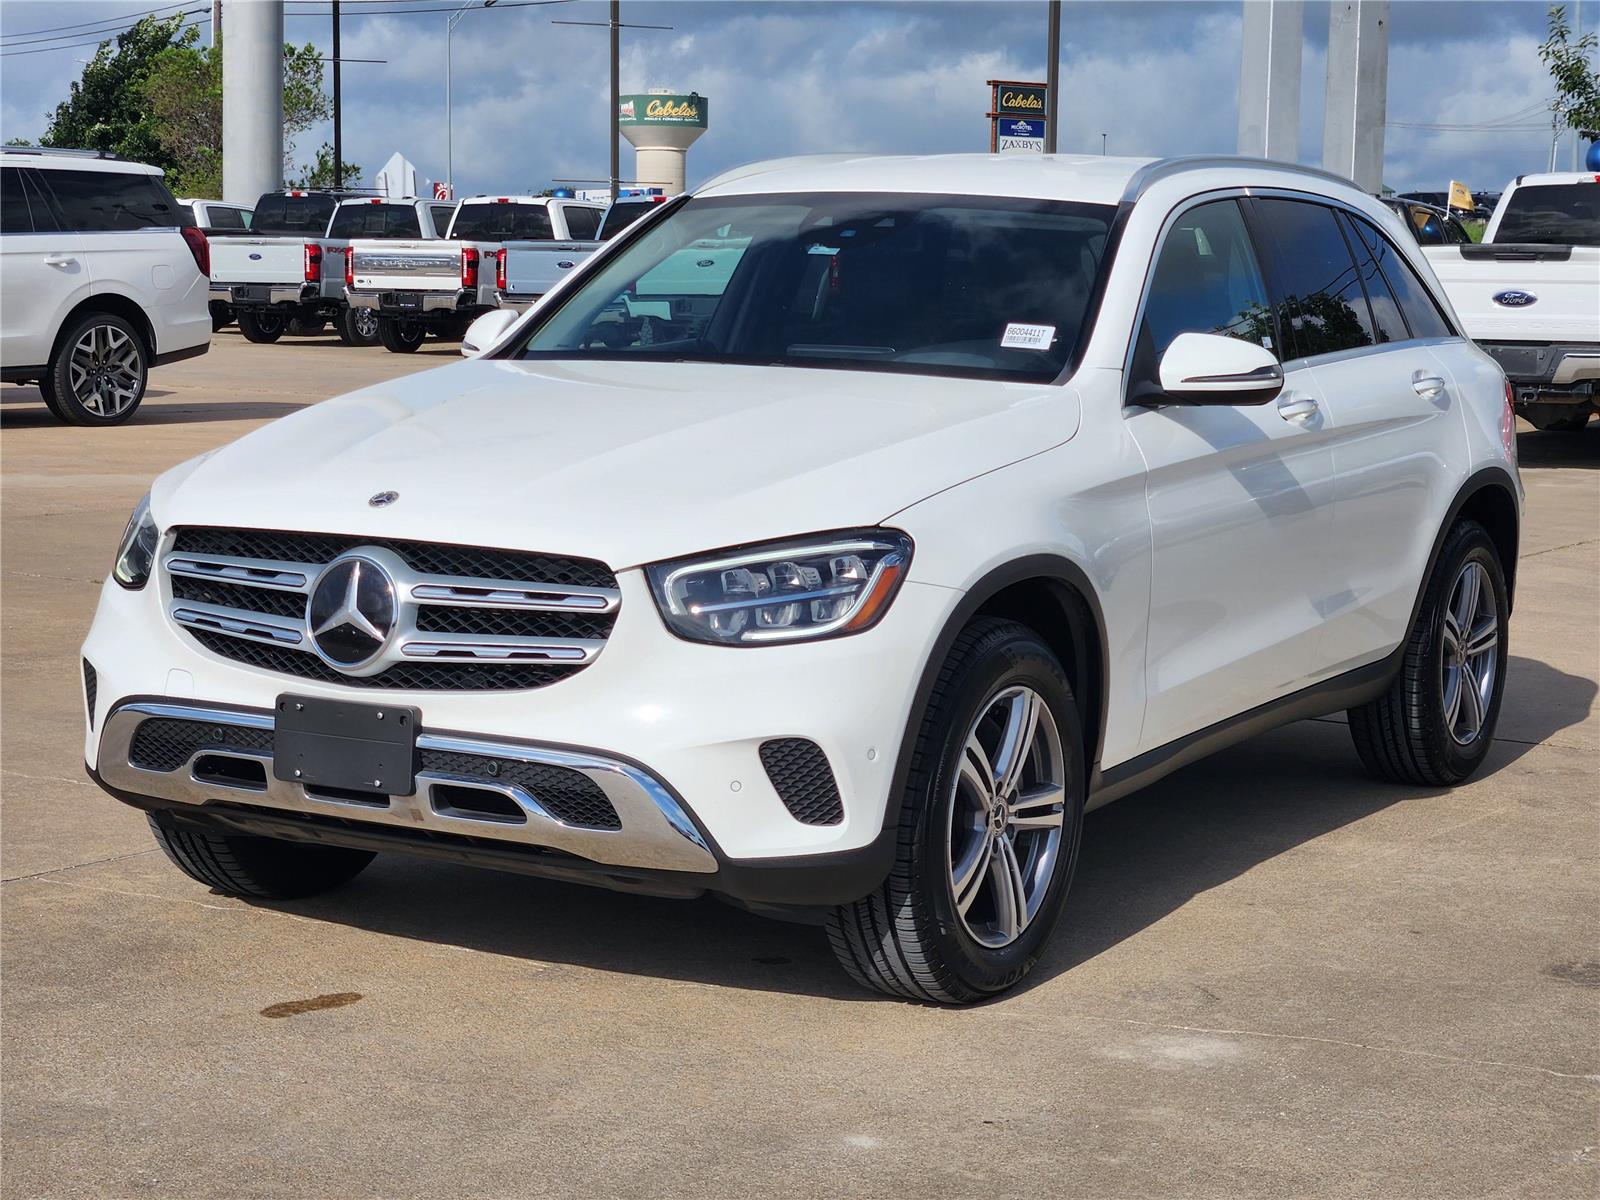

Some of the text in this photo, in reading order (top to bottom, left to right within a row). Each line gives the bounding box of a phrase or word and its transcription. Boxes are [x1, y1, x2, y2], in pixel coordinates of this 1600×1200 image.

[1002, 91, 1042, 109] Cabela's
[646, 99, 698, 118] Cabela's
[1001, 139, 1042, 152] ZAXBY'S
[1502, 292, 1528, 304] Ford
